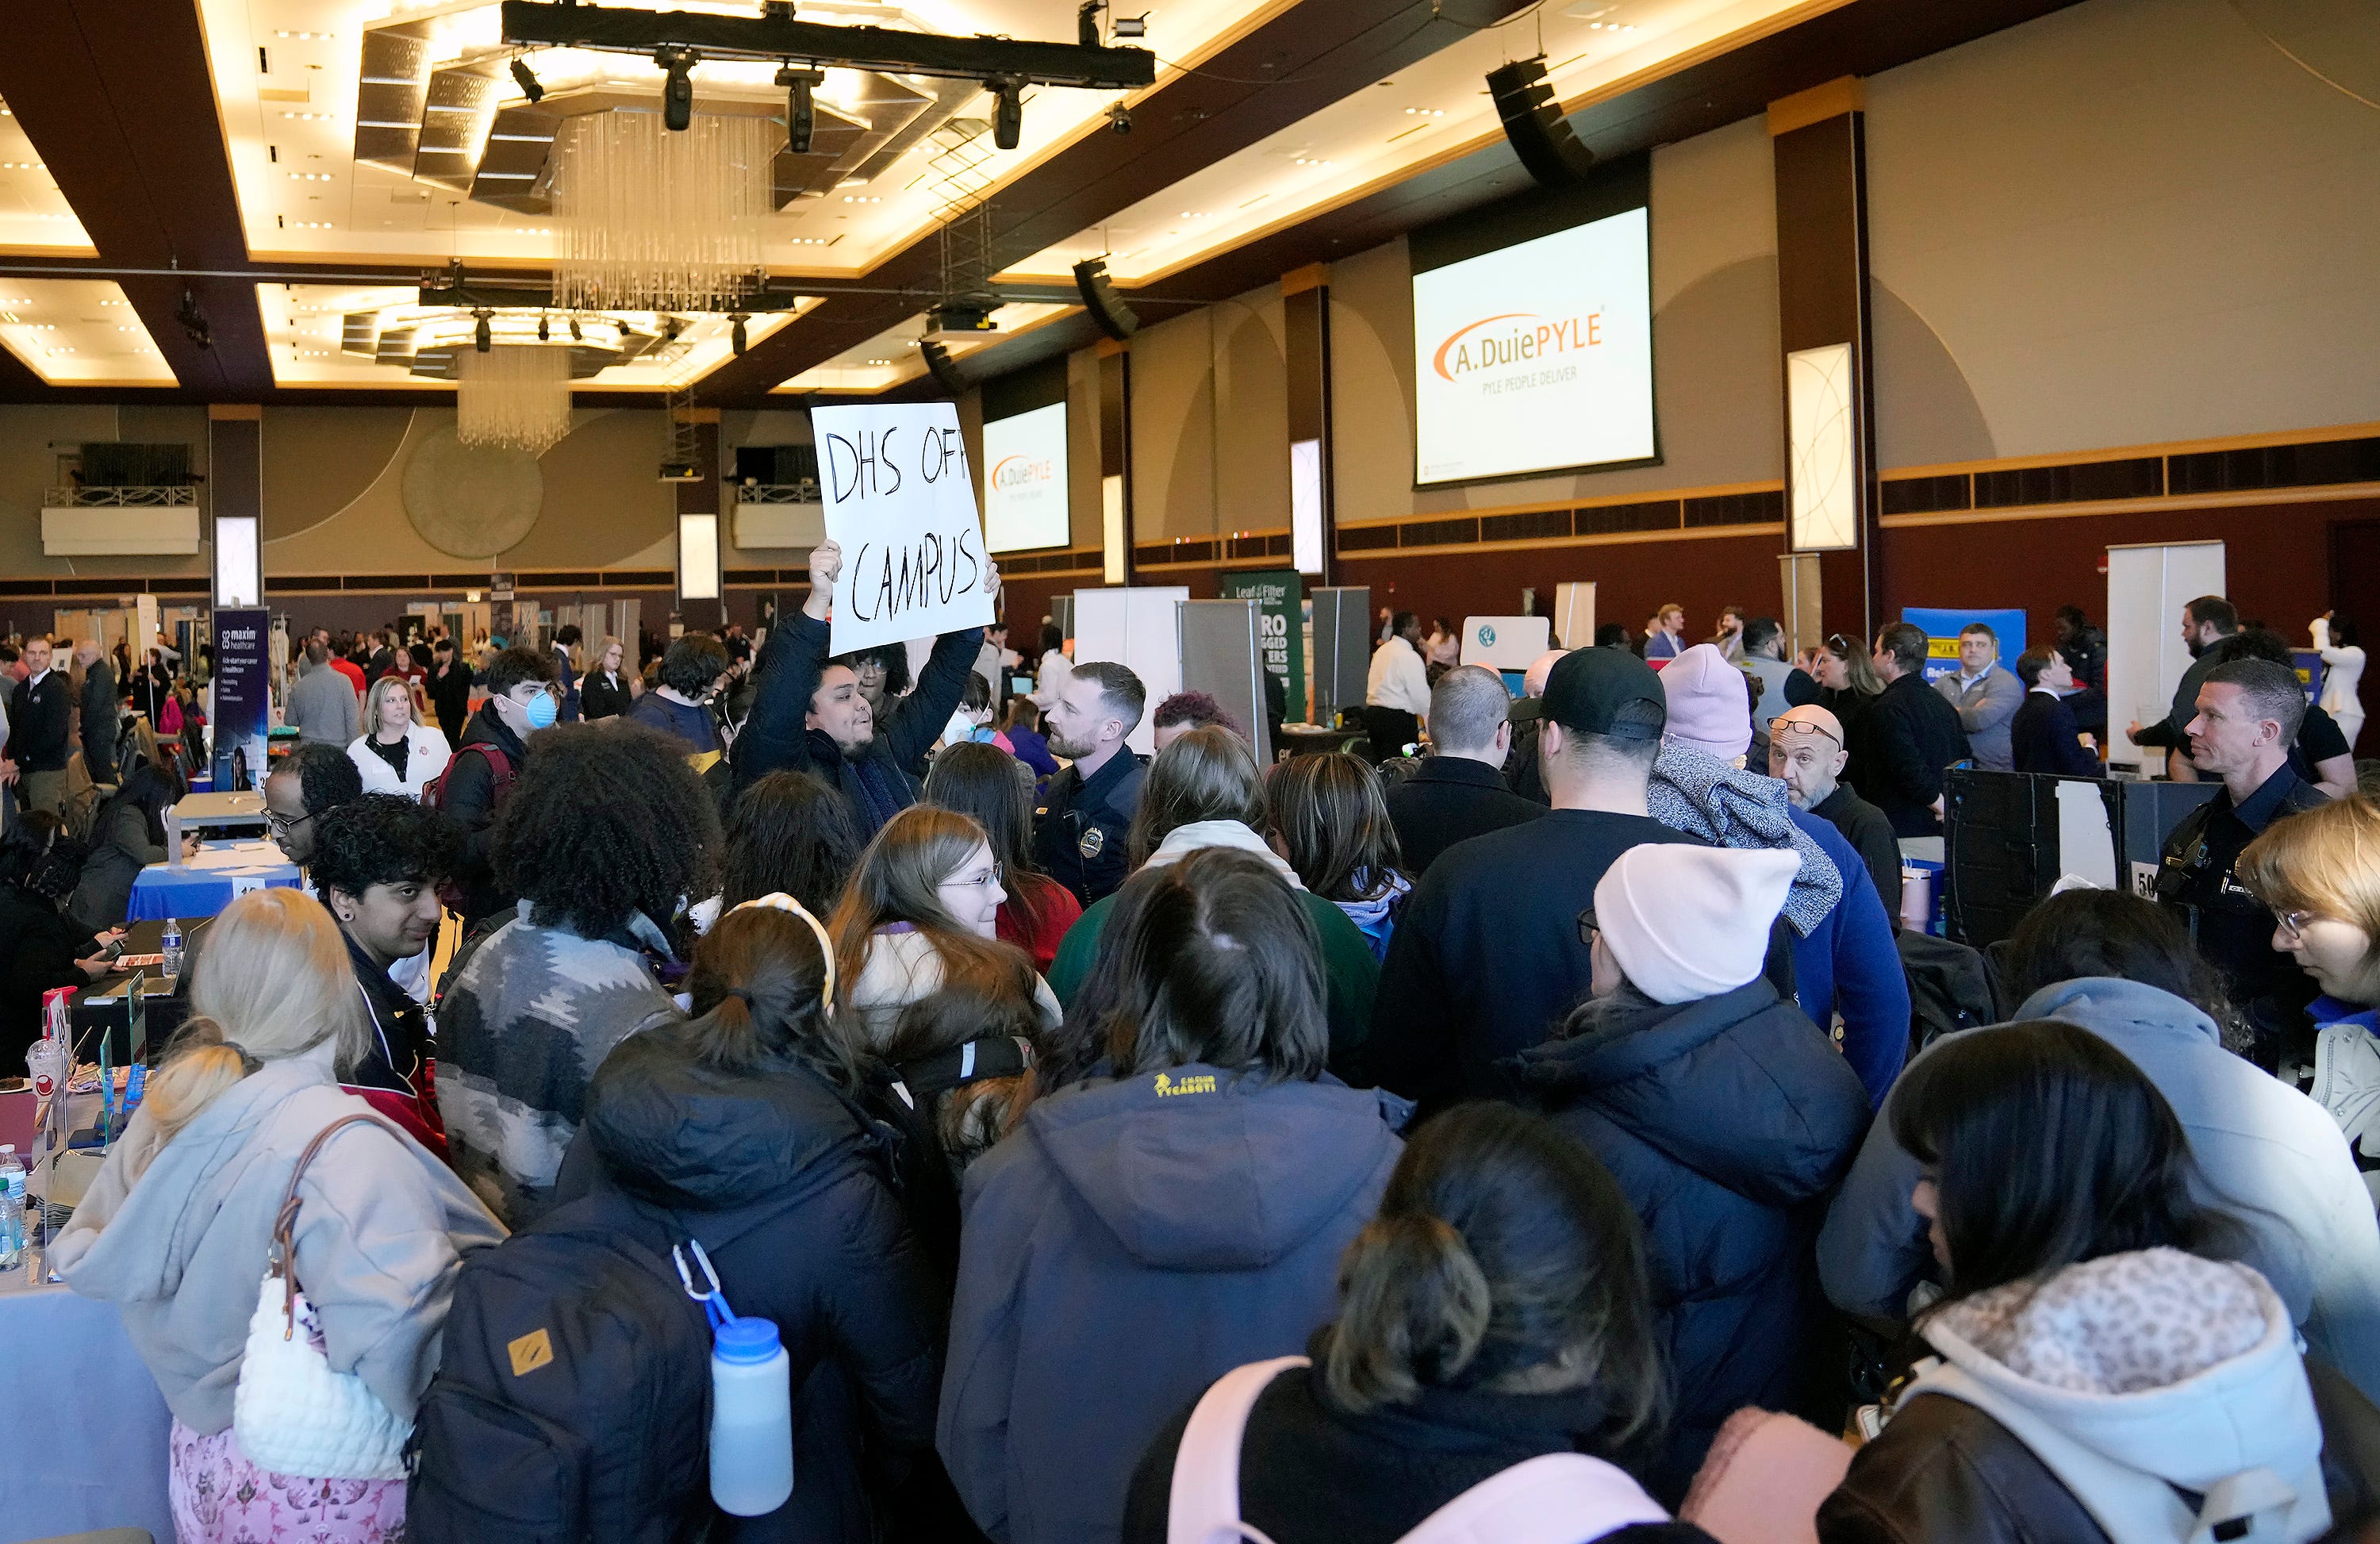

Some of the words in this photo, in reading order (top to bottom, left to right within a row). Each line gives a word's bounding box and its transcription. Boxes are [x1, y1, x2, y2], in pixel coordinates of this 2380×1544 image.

[1482, 381, 1503, 395] PYLE
[1505, 373, 1537, 392] PEOPLE
[1540, 366, 1577, 386] DELIVER
[827, 426, 901, 504] DHS
[852, 528, 977, 621] CAMPUS
[231, 626, 255, 640] maxim
[1261, 614, 1287, 636] RO
[231, 641, 255, 650] healthcare
[2138, 873, 2156, 898] 50
